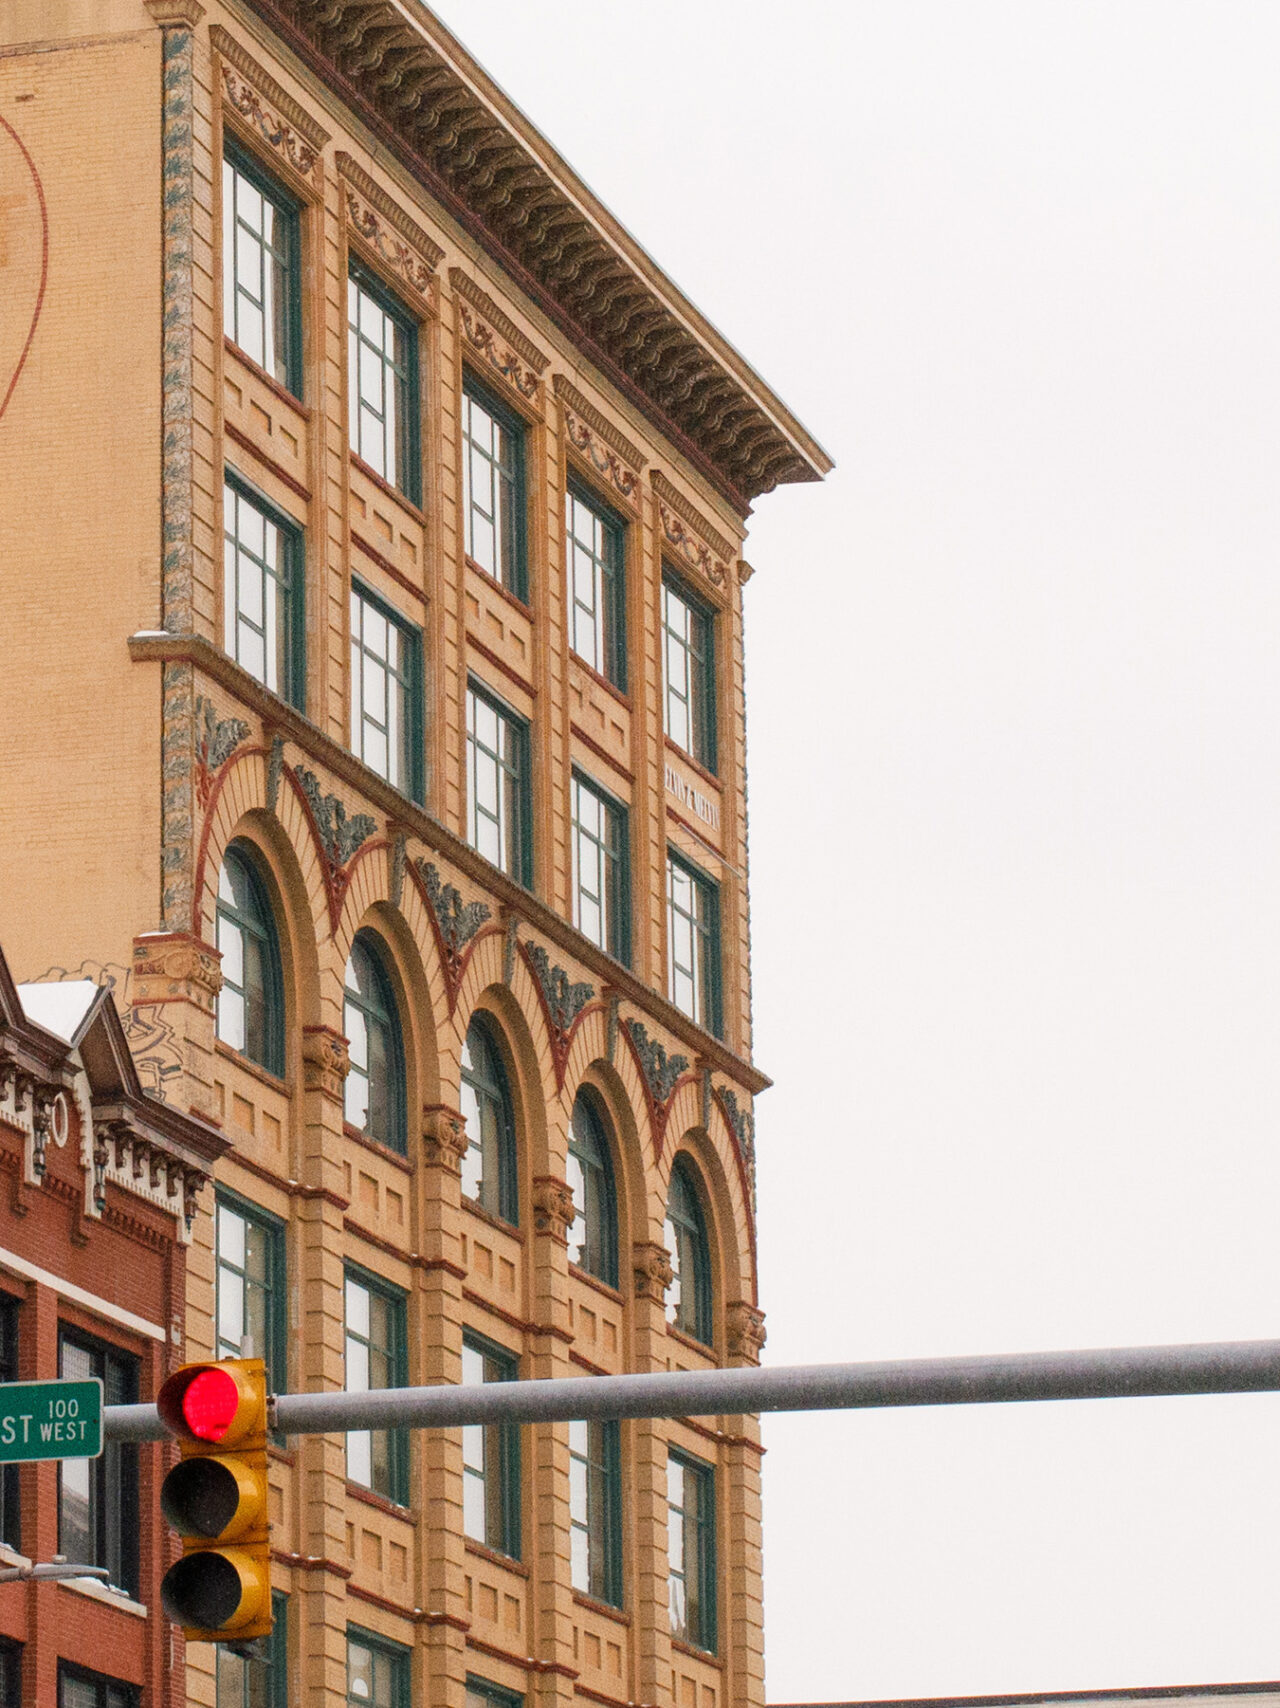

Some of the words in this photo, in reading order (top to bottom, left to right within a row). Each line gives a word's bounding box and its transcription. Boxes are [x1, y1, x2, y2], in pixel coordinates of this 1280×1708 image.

[48, 1399, 80, 1419] 100
[1, 1415, 33, 1444] ST
[39, 1421, 88, 1443] WEST
